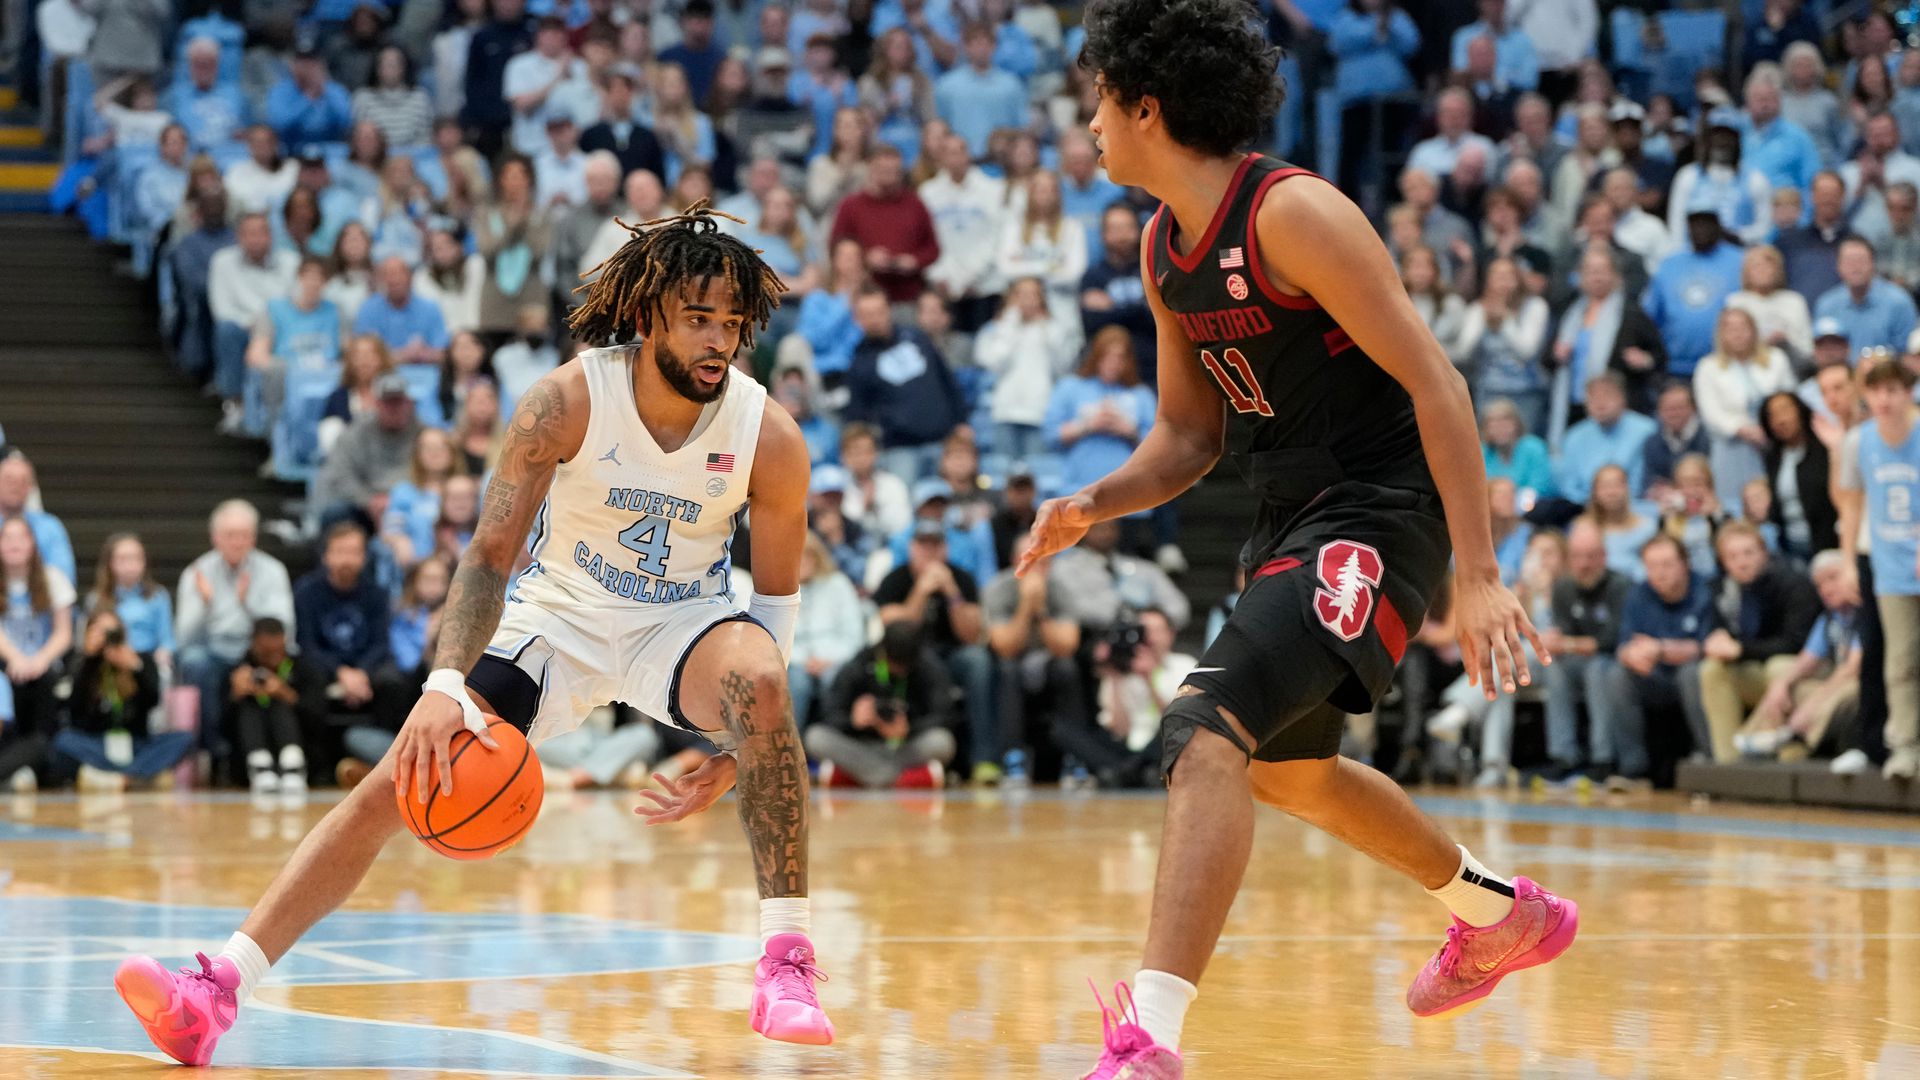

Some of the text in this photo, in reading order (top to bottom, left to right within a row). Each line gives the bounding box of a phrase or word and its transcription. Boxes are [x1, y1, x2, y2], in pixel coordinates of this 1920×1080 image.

[1176, 305, 1273, 342] ANFORD
[1200, 347, 1275, 417] 11
[605, 487, 703, 524] NORTH
[573, 540, 701, 604] CAROLINA
[617, 513, 672, 578] 4
[783, 842, 801, 897] FAI
